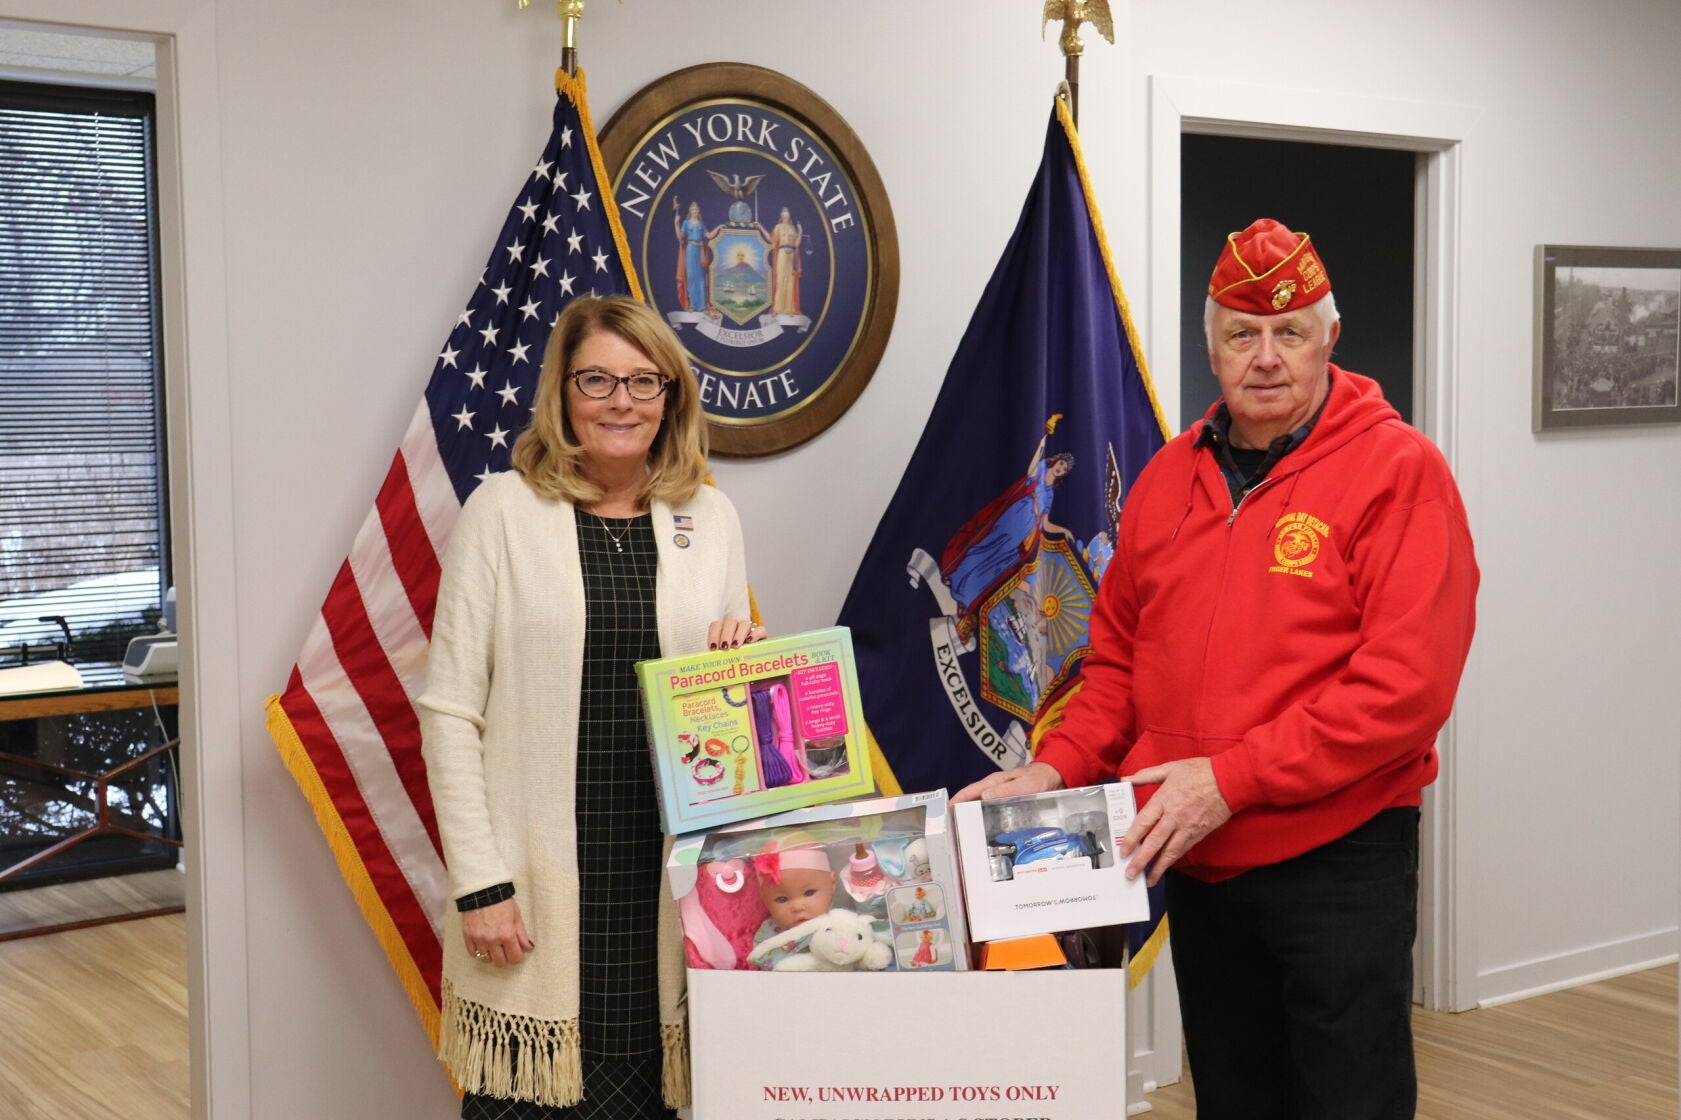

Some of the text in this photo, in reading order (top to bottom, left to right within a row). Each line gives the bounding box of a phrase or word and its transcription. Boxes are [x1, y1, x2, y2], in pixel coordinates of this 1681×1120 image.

[620, 112, 855, 234] NEW YORK STATE
[718, 328, 765, 340] EXCELSIOR
[1290, 568, 1313, 578] LAKES
[812, 649, 831, 659] BOOK
[670, 653, 809, 690] Paracord Bracelets
[680, 656, 741, 674] MAKE YOUR OWN
[682, 697, 716, 709] Paracord
[937, 642, 1008, 761] EXCELSIOR
[690, 711, 729, 723] Necklaces
[697, 723, 711, 732] Key
[713, 719, 738, 729] Chains
[763, 1085, 1059, 1104] NEW, UNWRAPPED TOYS ONLY
